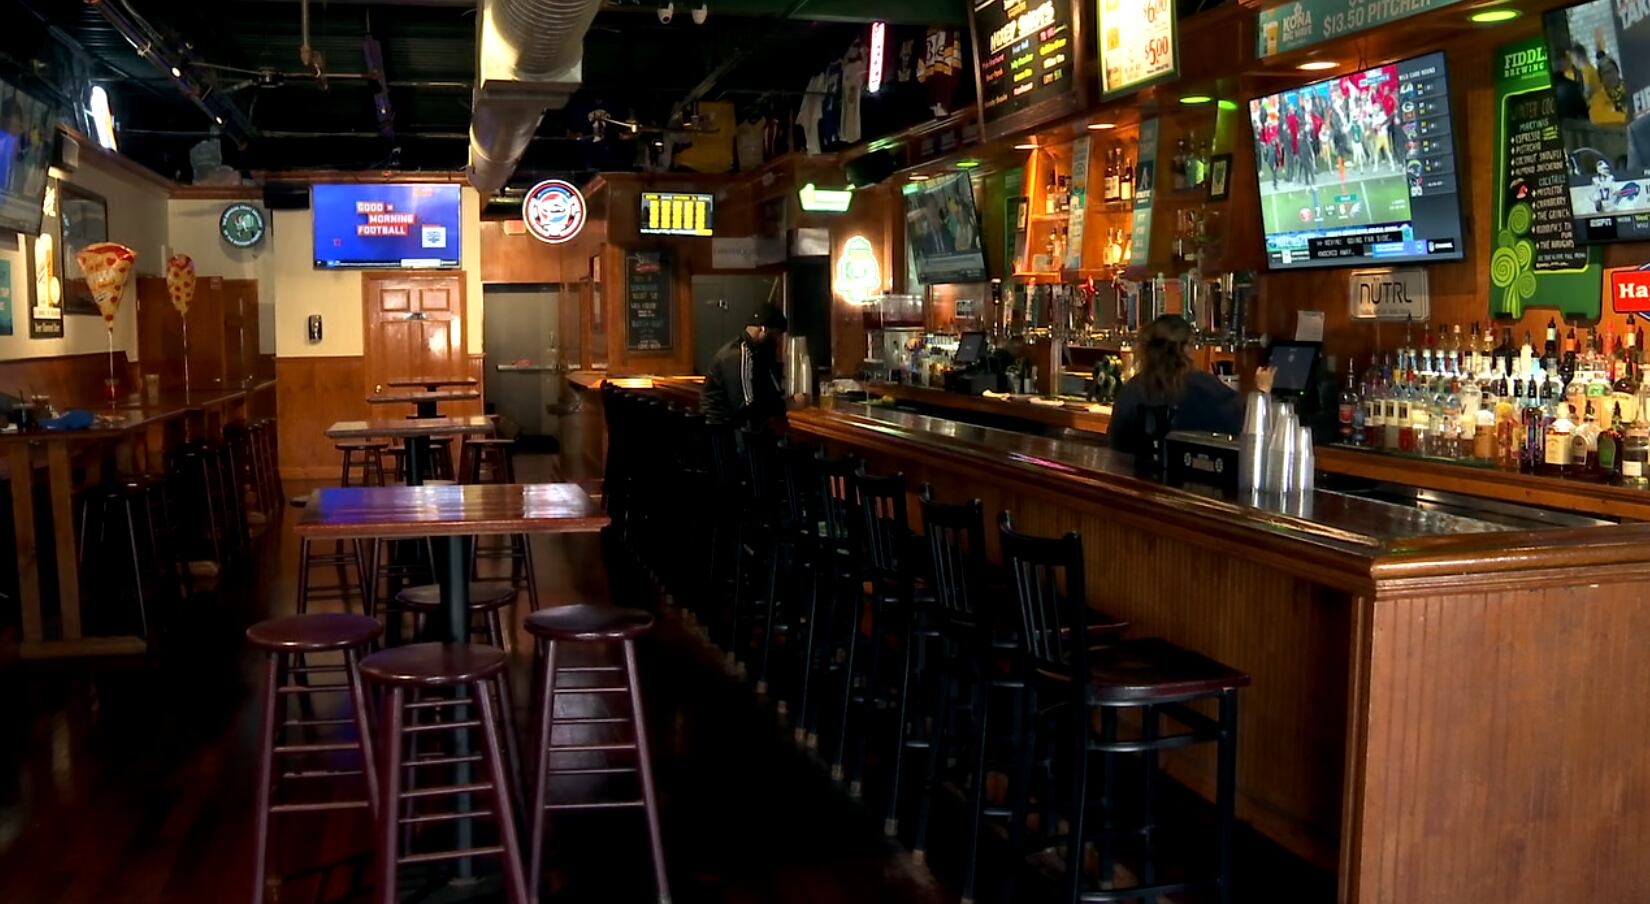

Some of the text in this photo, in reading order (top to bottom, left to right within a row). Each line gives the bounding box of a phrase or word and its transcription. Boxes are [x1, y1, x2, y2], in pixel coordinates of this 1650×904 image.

[1283, 11, 1312, 32] KONA
[1323, 7, 1364, 38] $13.50
[1144, 35, 1169, 66] $5.00
[1504, 47, 1547, 69] FIDDL
[1504, 62, 1545, 78] BREWING
[357, 203, 384, 213] GOOD
[368, 213, 415, 224] MORNING
[357, 225, 406, 235] FOOTBALL
[1618, 283, 1650, 302] Ha
